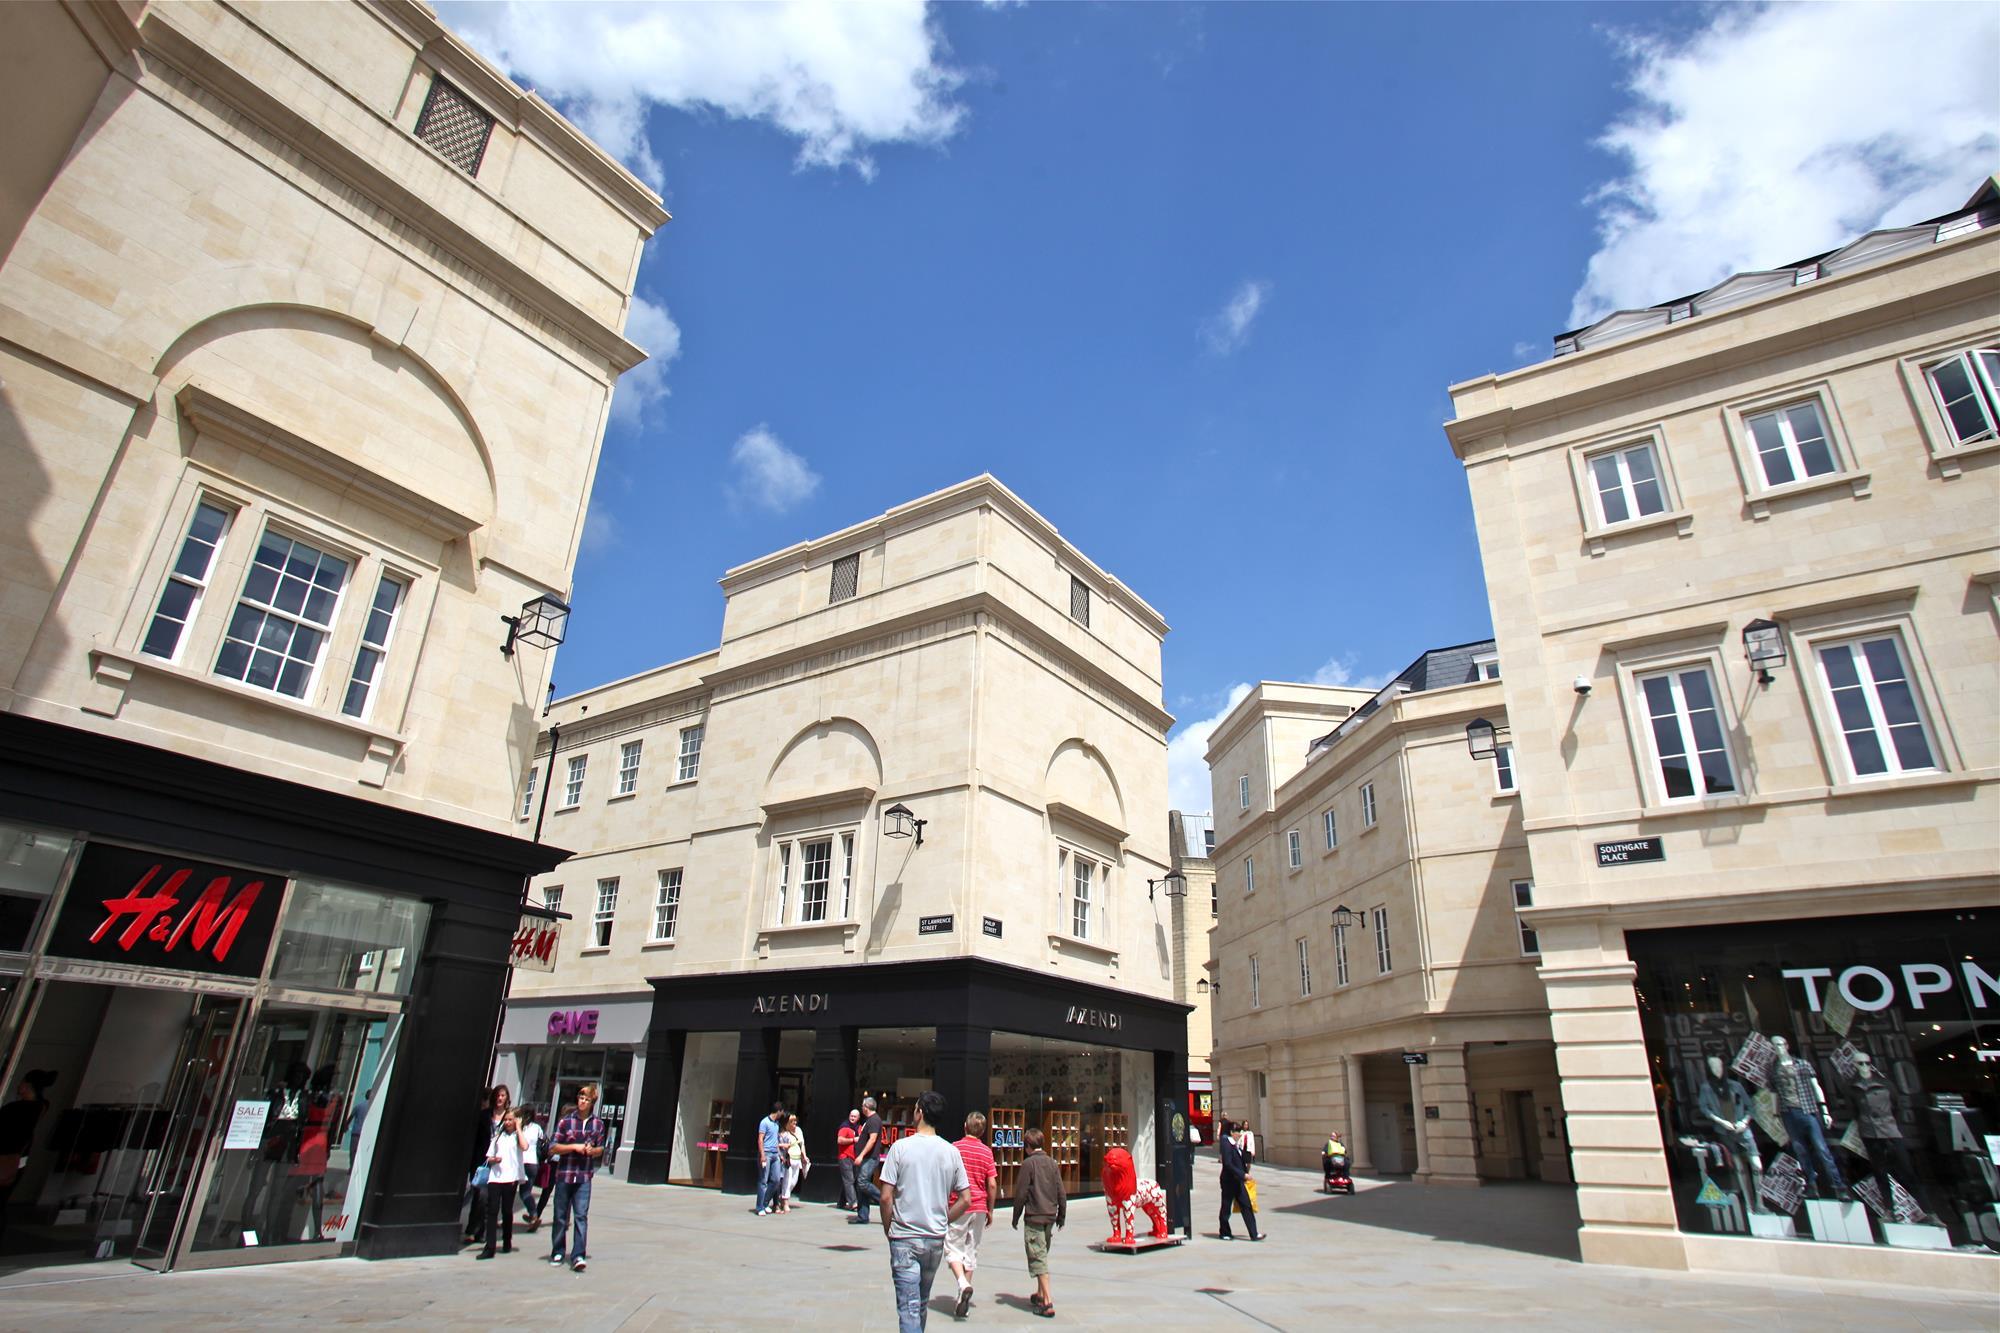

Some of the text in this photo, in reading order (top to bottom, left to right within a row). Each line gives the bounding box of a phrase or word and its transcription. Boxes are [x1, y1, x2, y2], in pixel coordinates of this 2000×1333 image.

[1600, 842, 1649, 853] SOUTHGATE
[1601, 853, 1628, 861] PLACE
[89, 864, 265, 962] H&M
[928, 917, 951, 925] LAWRENCE
[511, 926, 557, 963] H&M
[752, 993, 829, 1013] AZENDI
[548, 1010, 599, 1036] GAME
[1065, 1005, 1122, 1030] AZENDI
[237, 1106, 264, 1116] SALE
[995, 1130, 1024, 1147] SAL
